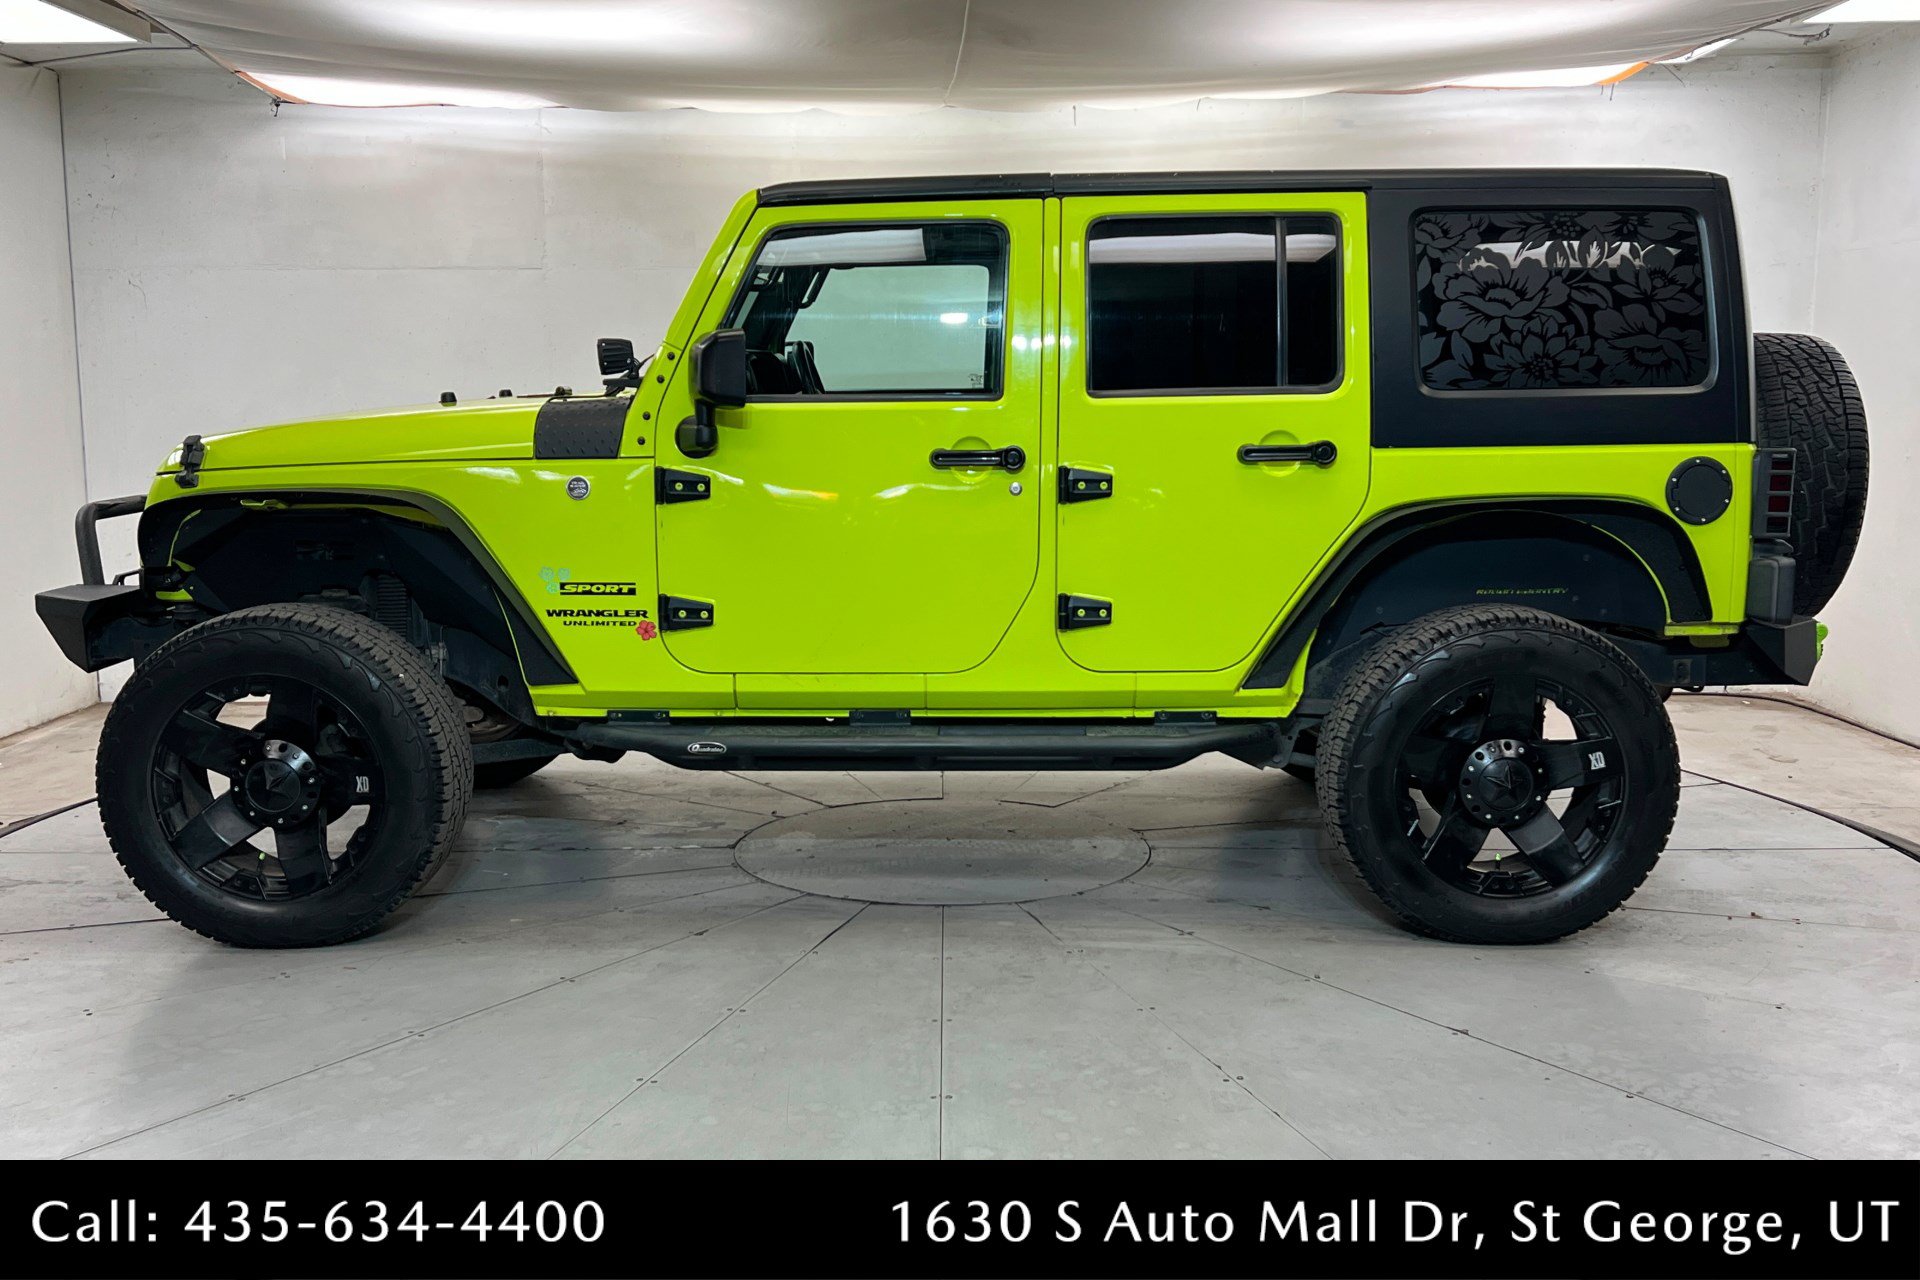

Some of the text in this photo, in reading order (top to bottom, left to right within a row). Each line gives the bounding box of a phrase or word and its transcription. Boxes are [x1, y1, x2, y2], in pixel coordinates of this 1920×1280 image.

[560, 584, 636, 593] SPORT
[546, 609, 649, 618] WRANGLER
[1587, 751, 1607, 770] XD
[355, 775, 370, 793] XD
